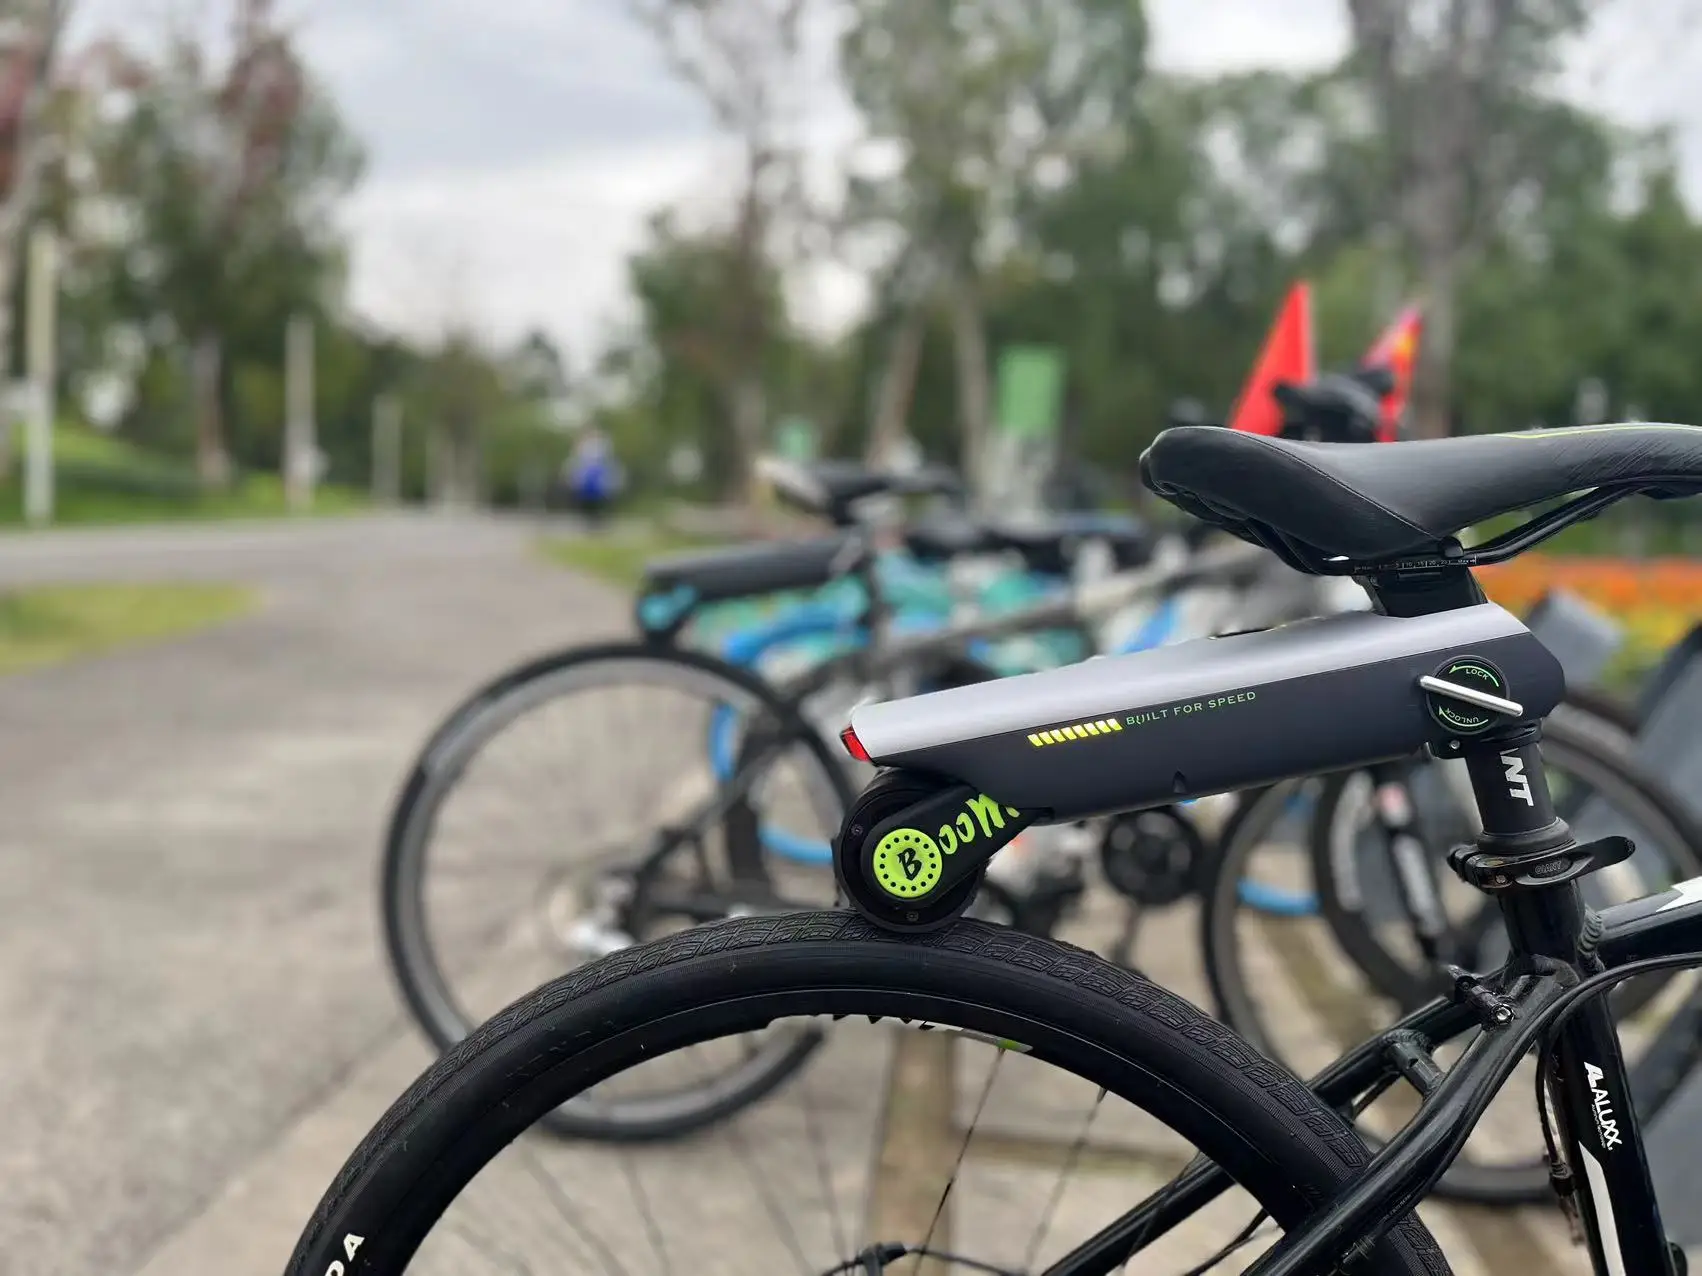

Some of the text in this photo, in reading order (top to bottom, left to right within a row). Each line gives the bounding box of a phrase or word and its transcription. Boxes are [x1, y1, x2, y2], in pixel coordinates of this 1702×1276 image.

[1465, 668, 1489, 680] LOCK
[1126, 691, 1257, 726] BUILT FOR SPEED
[1445, 707, 1480, 724] UNLOCK
